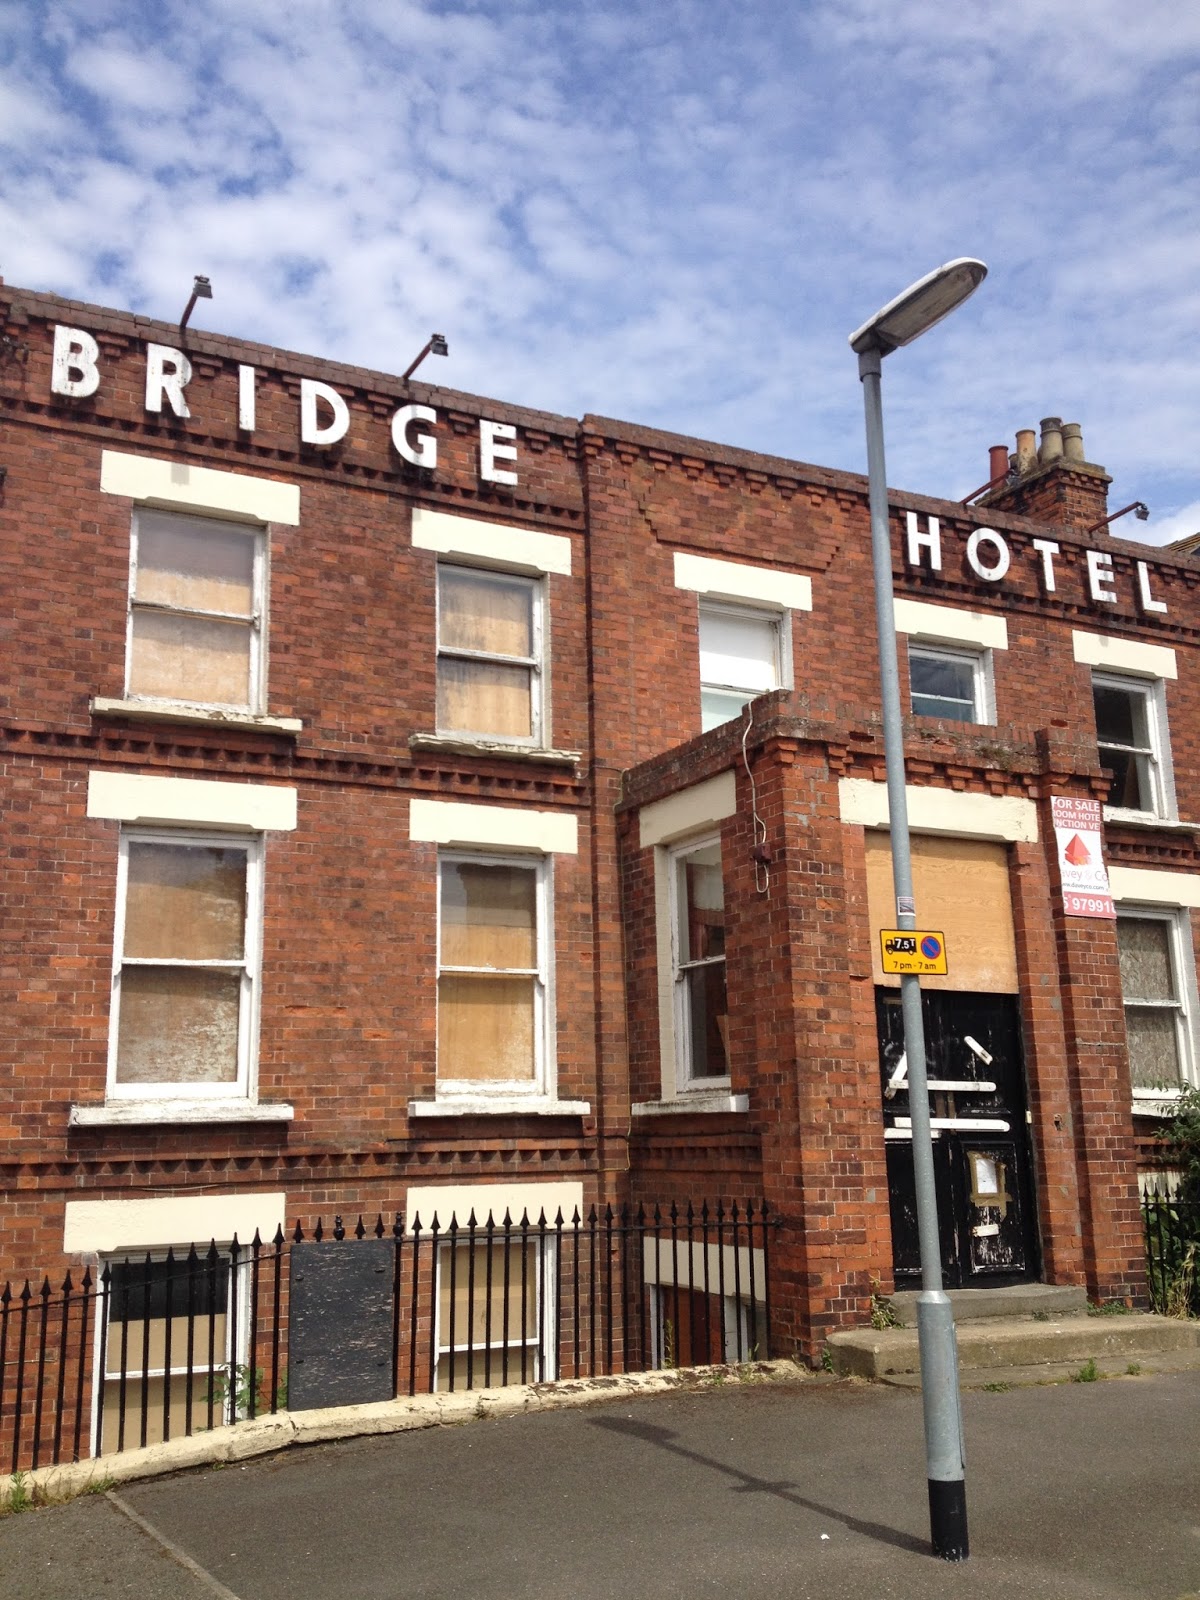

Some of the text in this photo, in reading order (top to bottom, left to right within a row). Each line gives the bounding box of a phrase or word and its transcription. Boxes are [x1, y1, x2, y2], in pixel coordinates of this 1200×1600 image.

[51, 324, 1168, 614] BRIDGE HOTEL
[1052, 798, 1100, 812] FOR SALE
[1078, 812, 1100, 822] HOTE
[893, 961, 898, 969] 7
[900, 962, 912, 970] pm
[918, 961, 923, 969] 7
